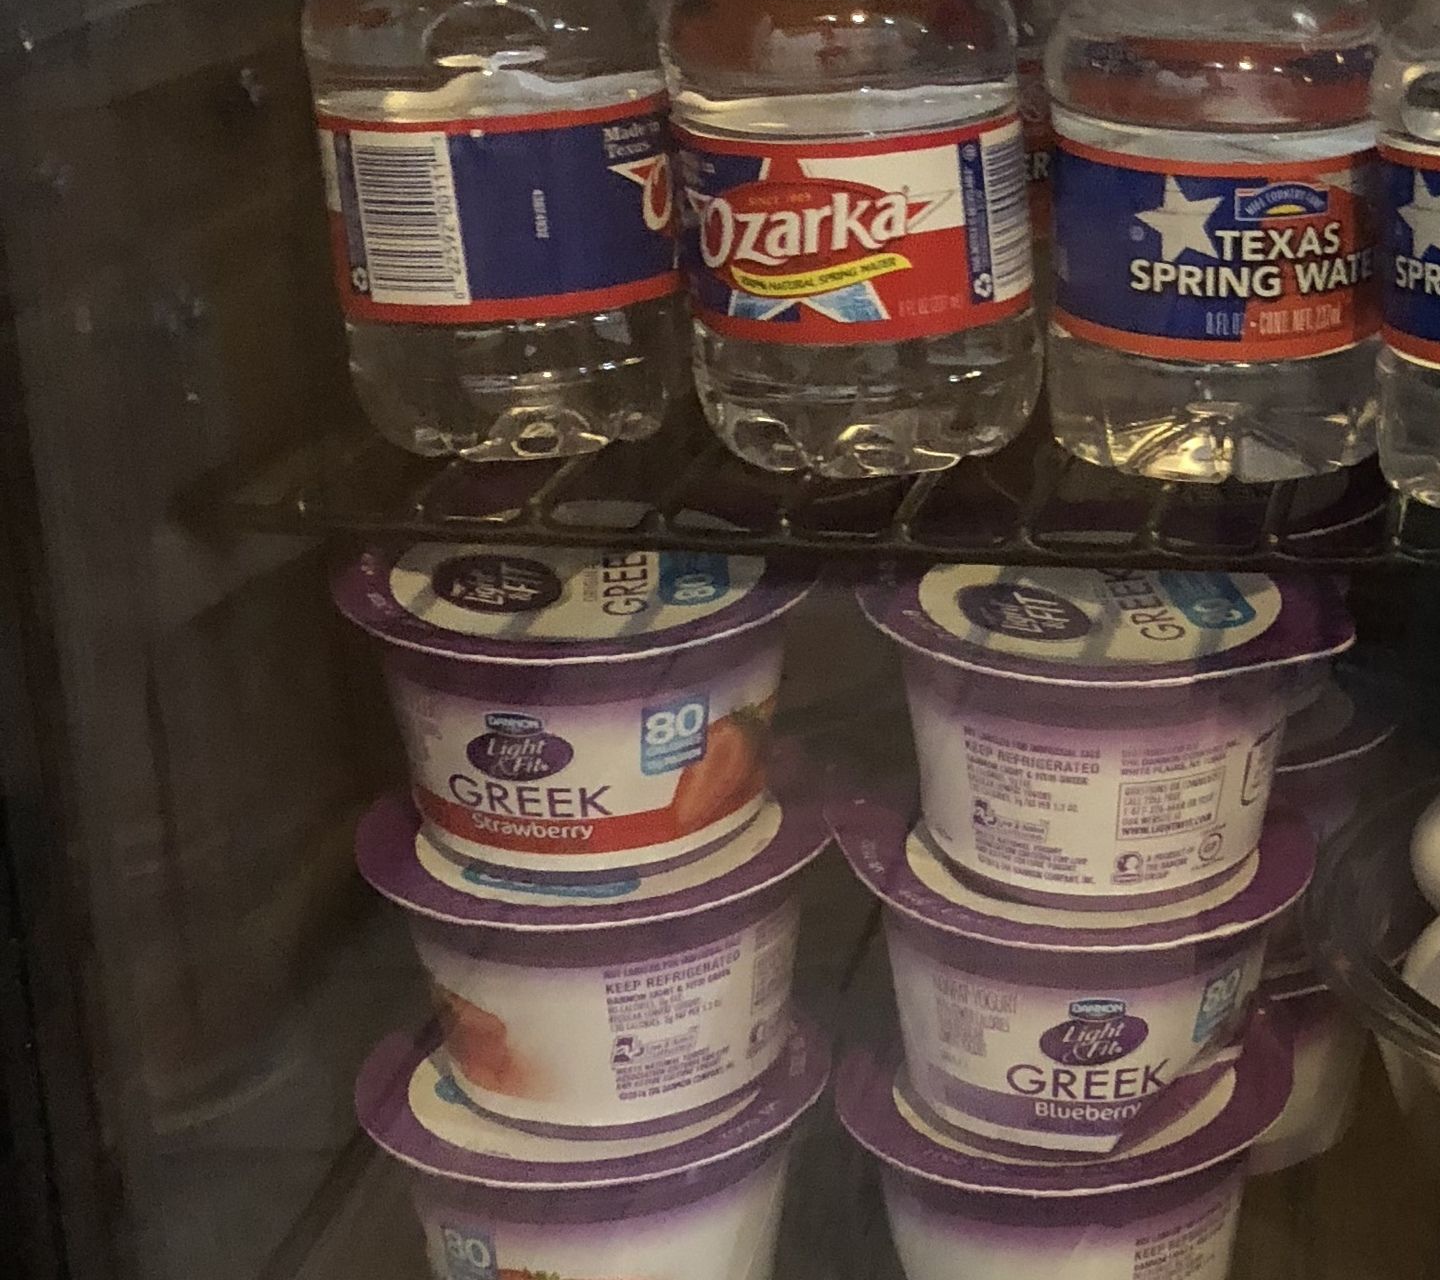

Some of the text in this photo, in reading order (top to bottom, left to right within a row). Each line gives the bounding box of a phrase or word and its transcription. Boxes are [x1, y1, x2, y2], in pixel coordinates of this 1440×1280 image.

[700, 193, 906, 268] Ozarka
[1215, 222, 1341, 261] TEXAS
[1130, 248, 1374, 298] SPRING WATE
[602, 554, 648, 616] GREE
[645, 703, 704, 745] 80
[486, 738, 546, 761] Light
[449, 774, 613, 818] GREEK
[472, 813, 594, 840] Strawberry
[606, 980, 641, 994] KEEP
[647, 949, 740, 988] REFRIGERATED
[1063, 1022, 1125, 1047] Light
[1006, 1058, 1170, 1100] GREEK
[1035, 1101, 1142, 1121] Blueberry
